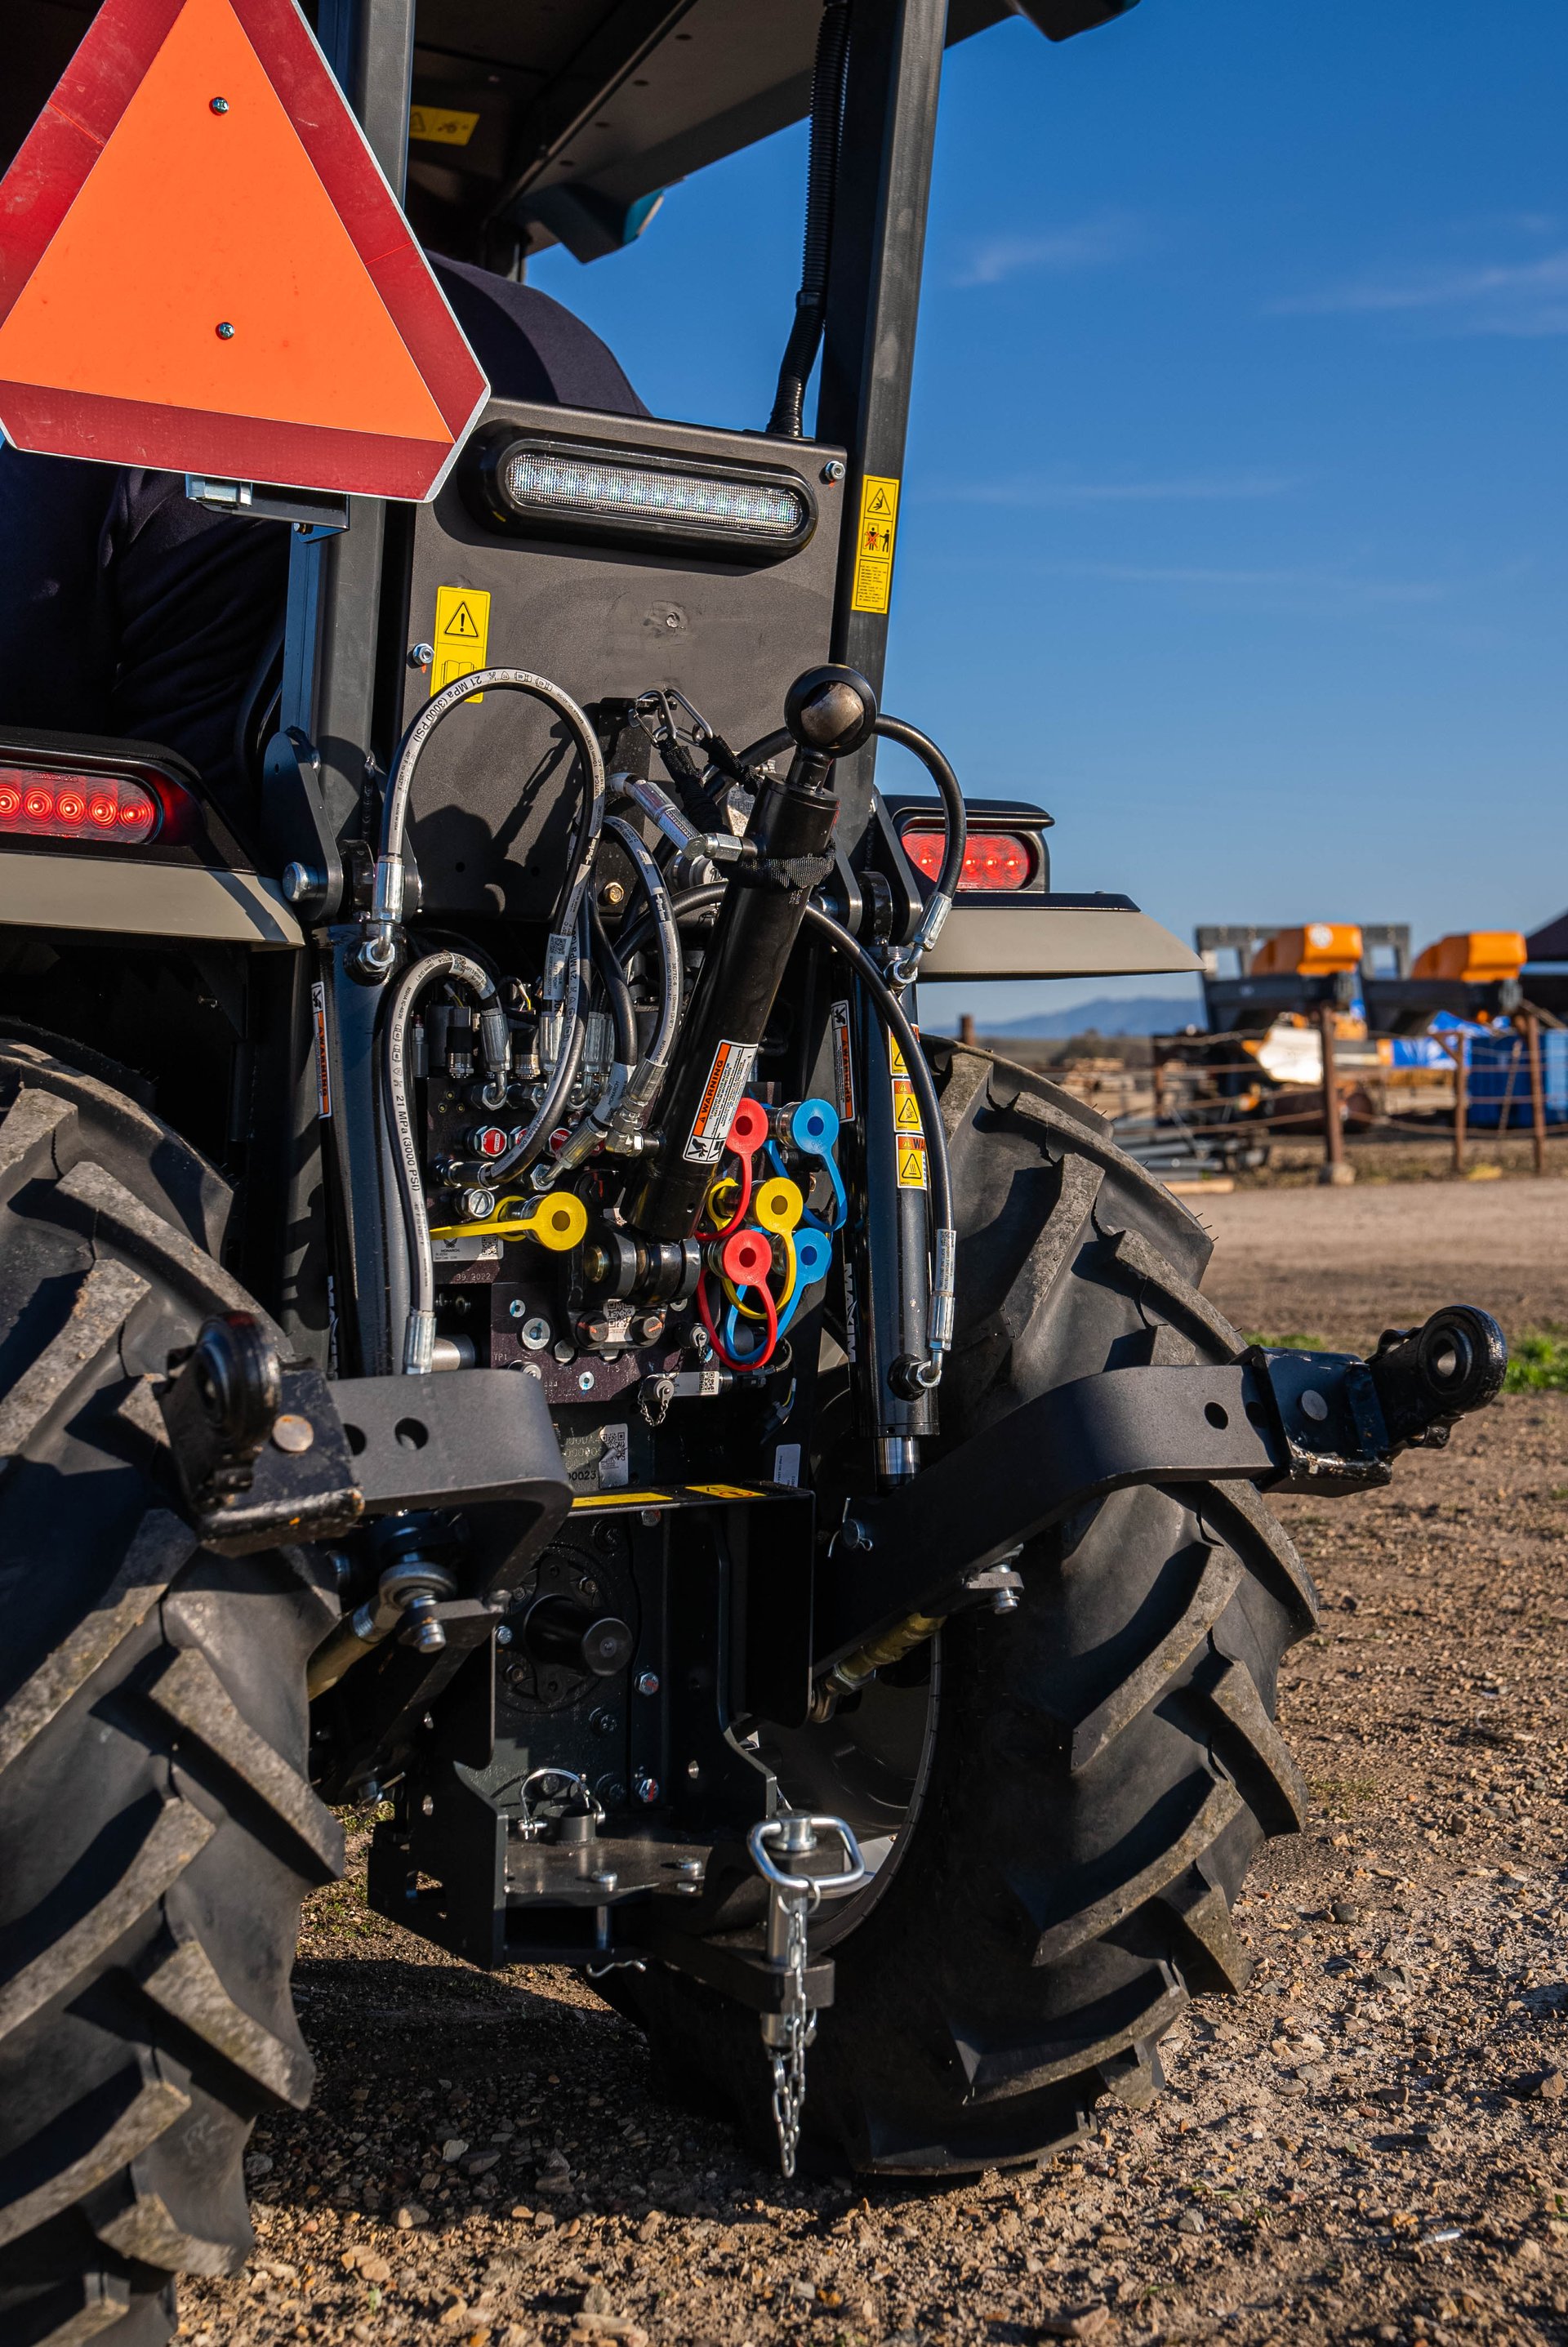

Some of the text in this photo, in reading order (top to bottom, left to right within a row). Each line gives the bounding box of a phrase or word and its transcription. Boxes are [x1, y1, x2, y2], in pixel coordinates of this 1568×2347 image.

[413, 675, 482, 742] 21 MPa (3000 PSI)
[701, 1058, 724, 1114] WARNING
[396, 1095, 420, 1191] 21 MPa (3000 PSI)
